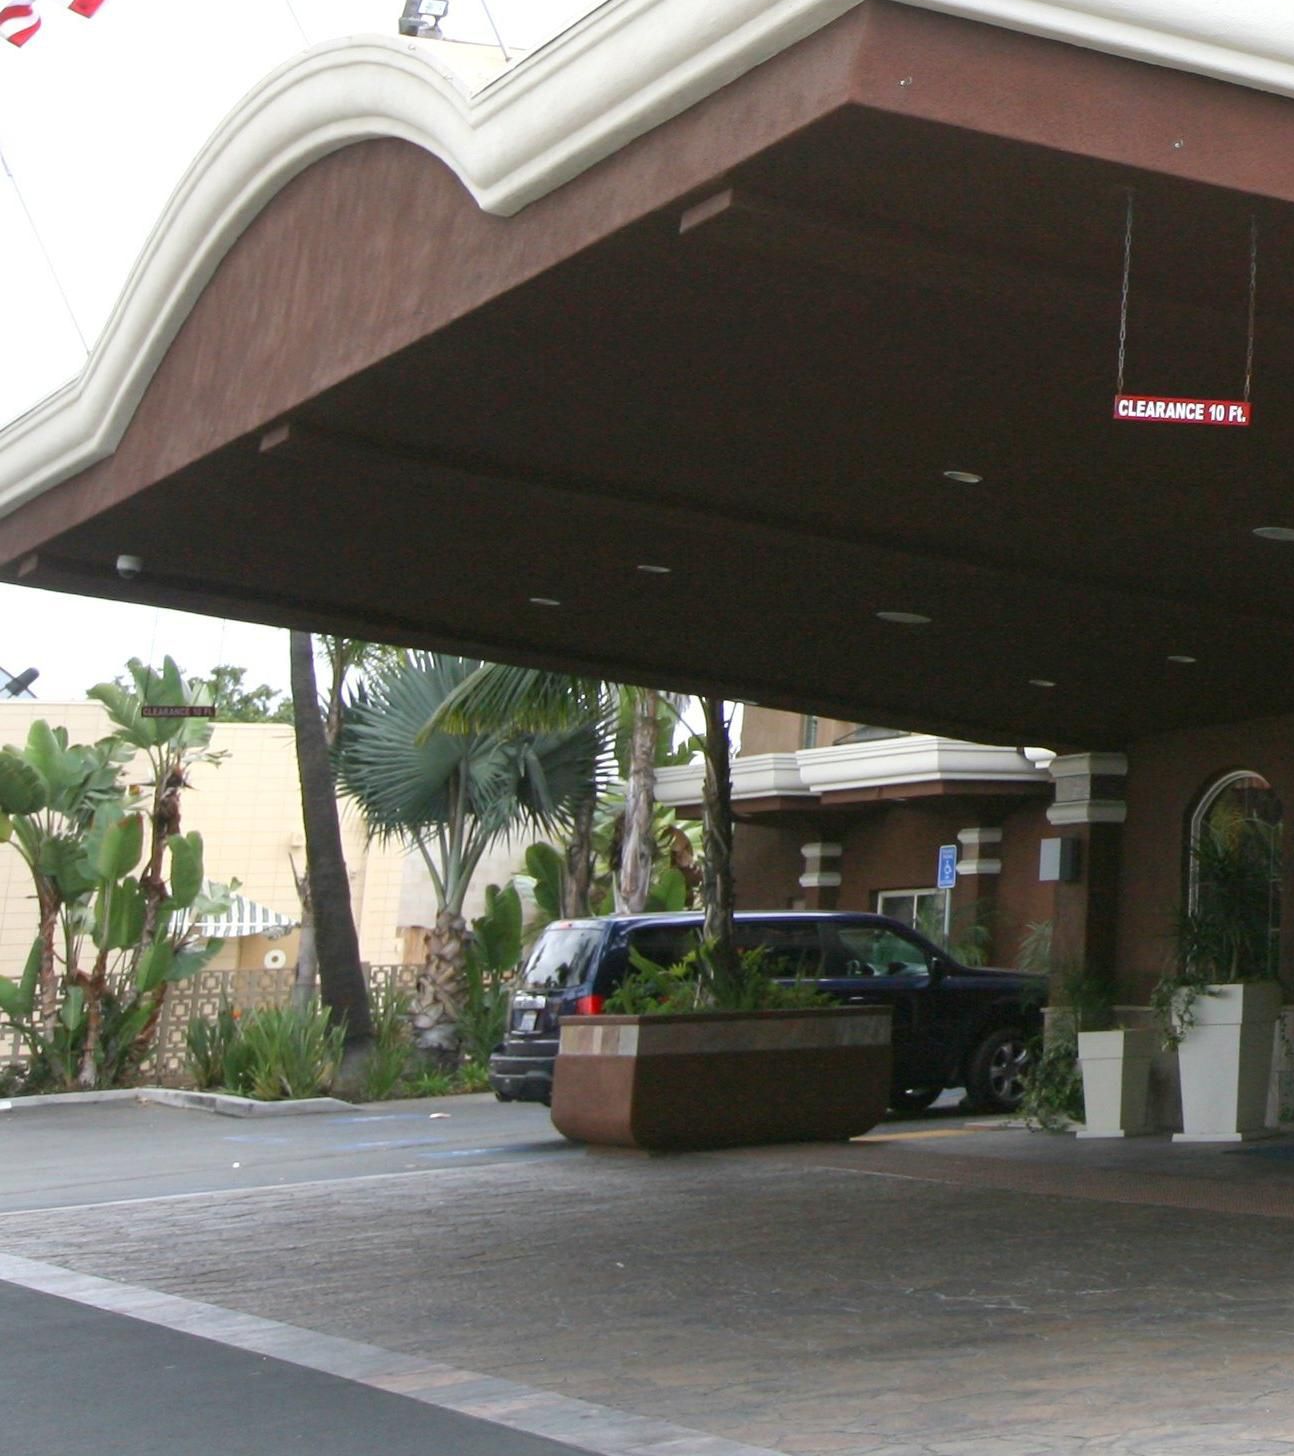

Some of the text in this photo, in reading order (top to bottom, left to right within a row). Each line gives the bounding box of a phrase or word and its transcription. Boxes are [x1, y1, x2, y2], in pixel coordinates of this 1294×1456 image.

[1118, 399, 1247, 423] CLEARANCE 10 Ft.
